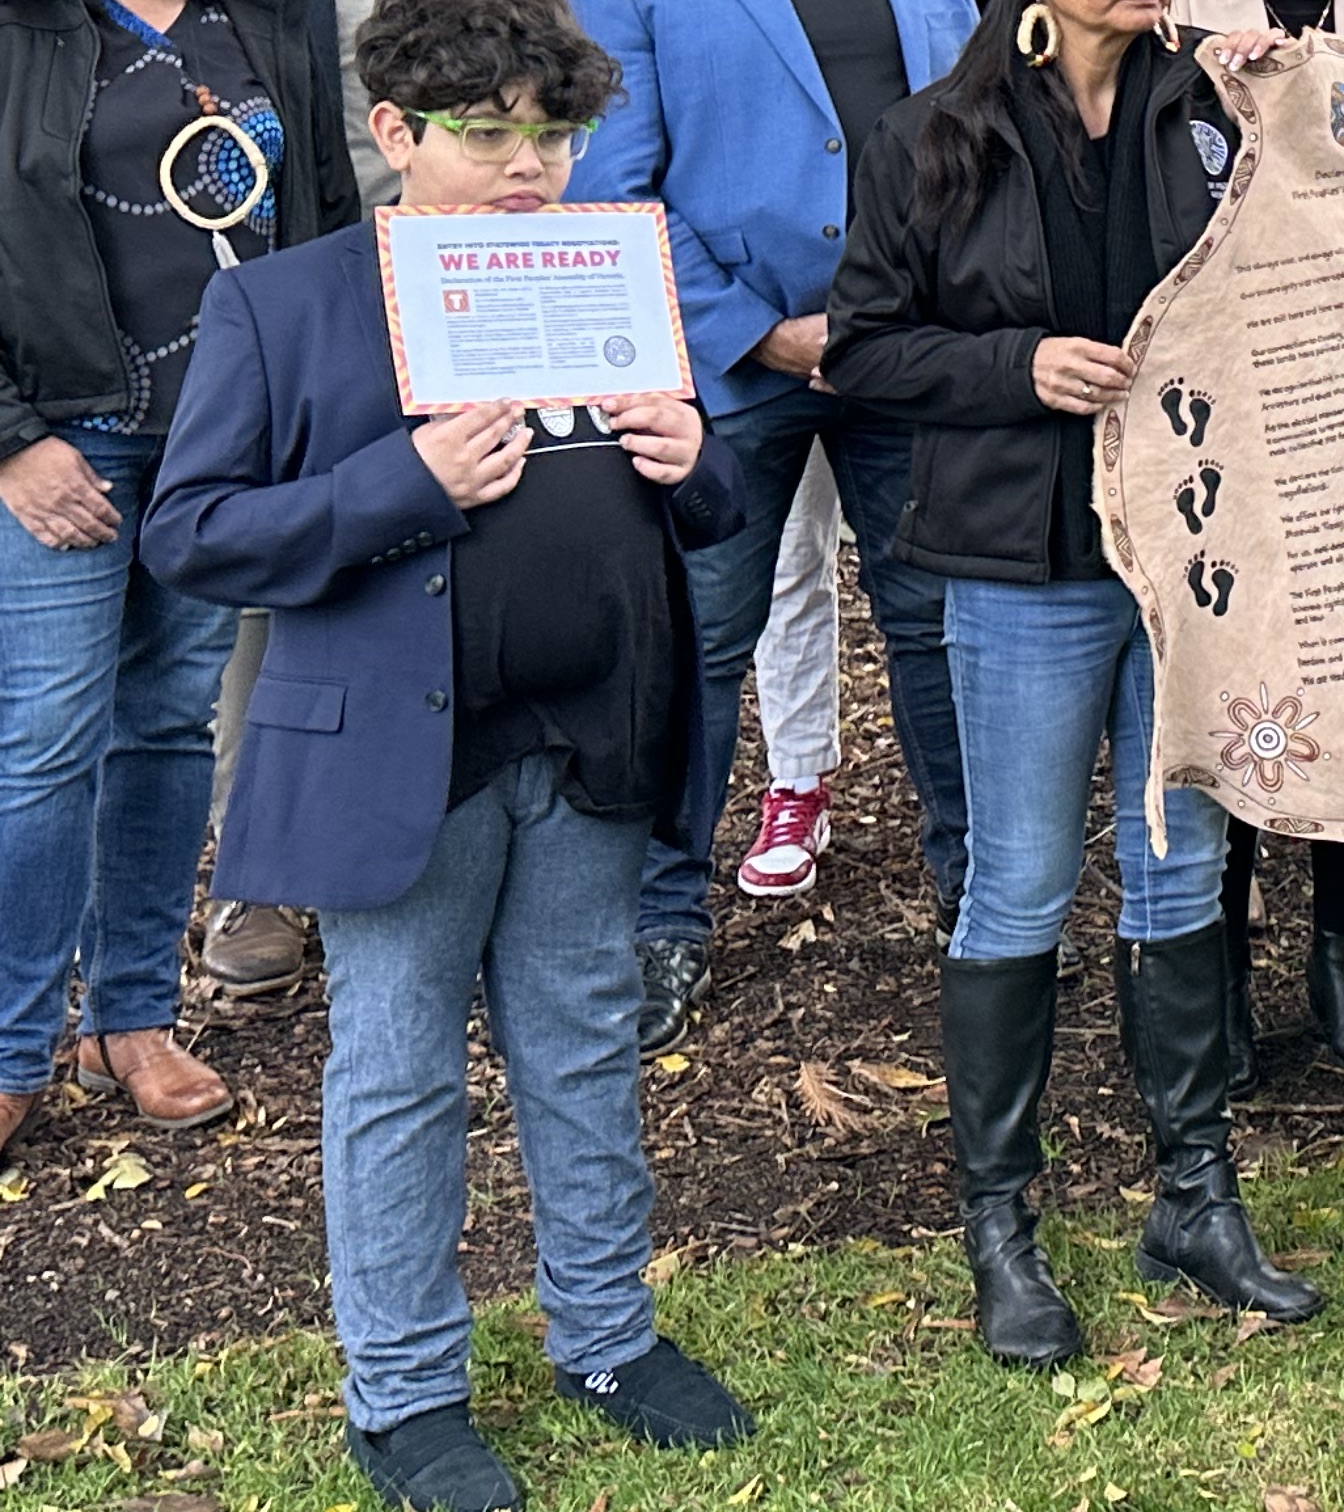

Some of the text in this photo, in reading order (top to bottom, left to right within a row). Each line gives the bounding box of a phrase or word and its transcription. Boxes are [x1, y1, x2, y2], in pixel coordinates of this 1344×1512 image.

[439, 250, 621, 271] WE ARE READY
[449, 294, 463, 310] T
